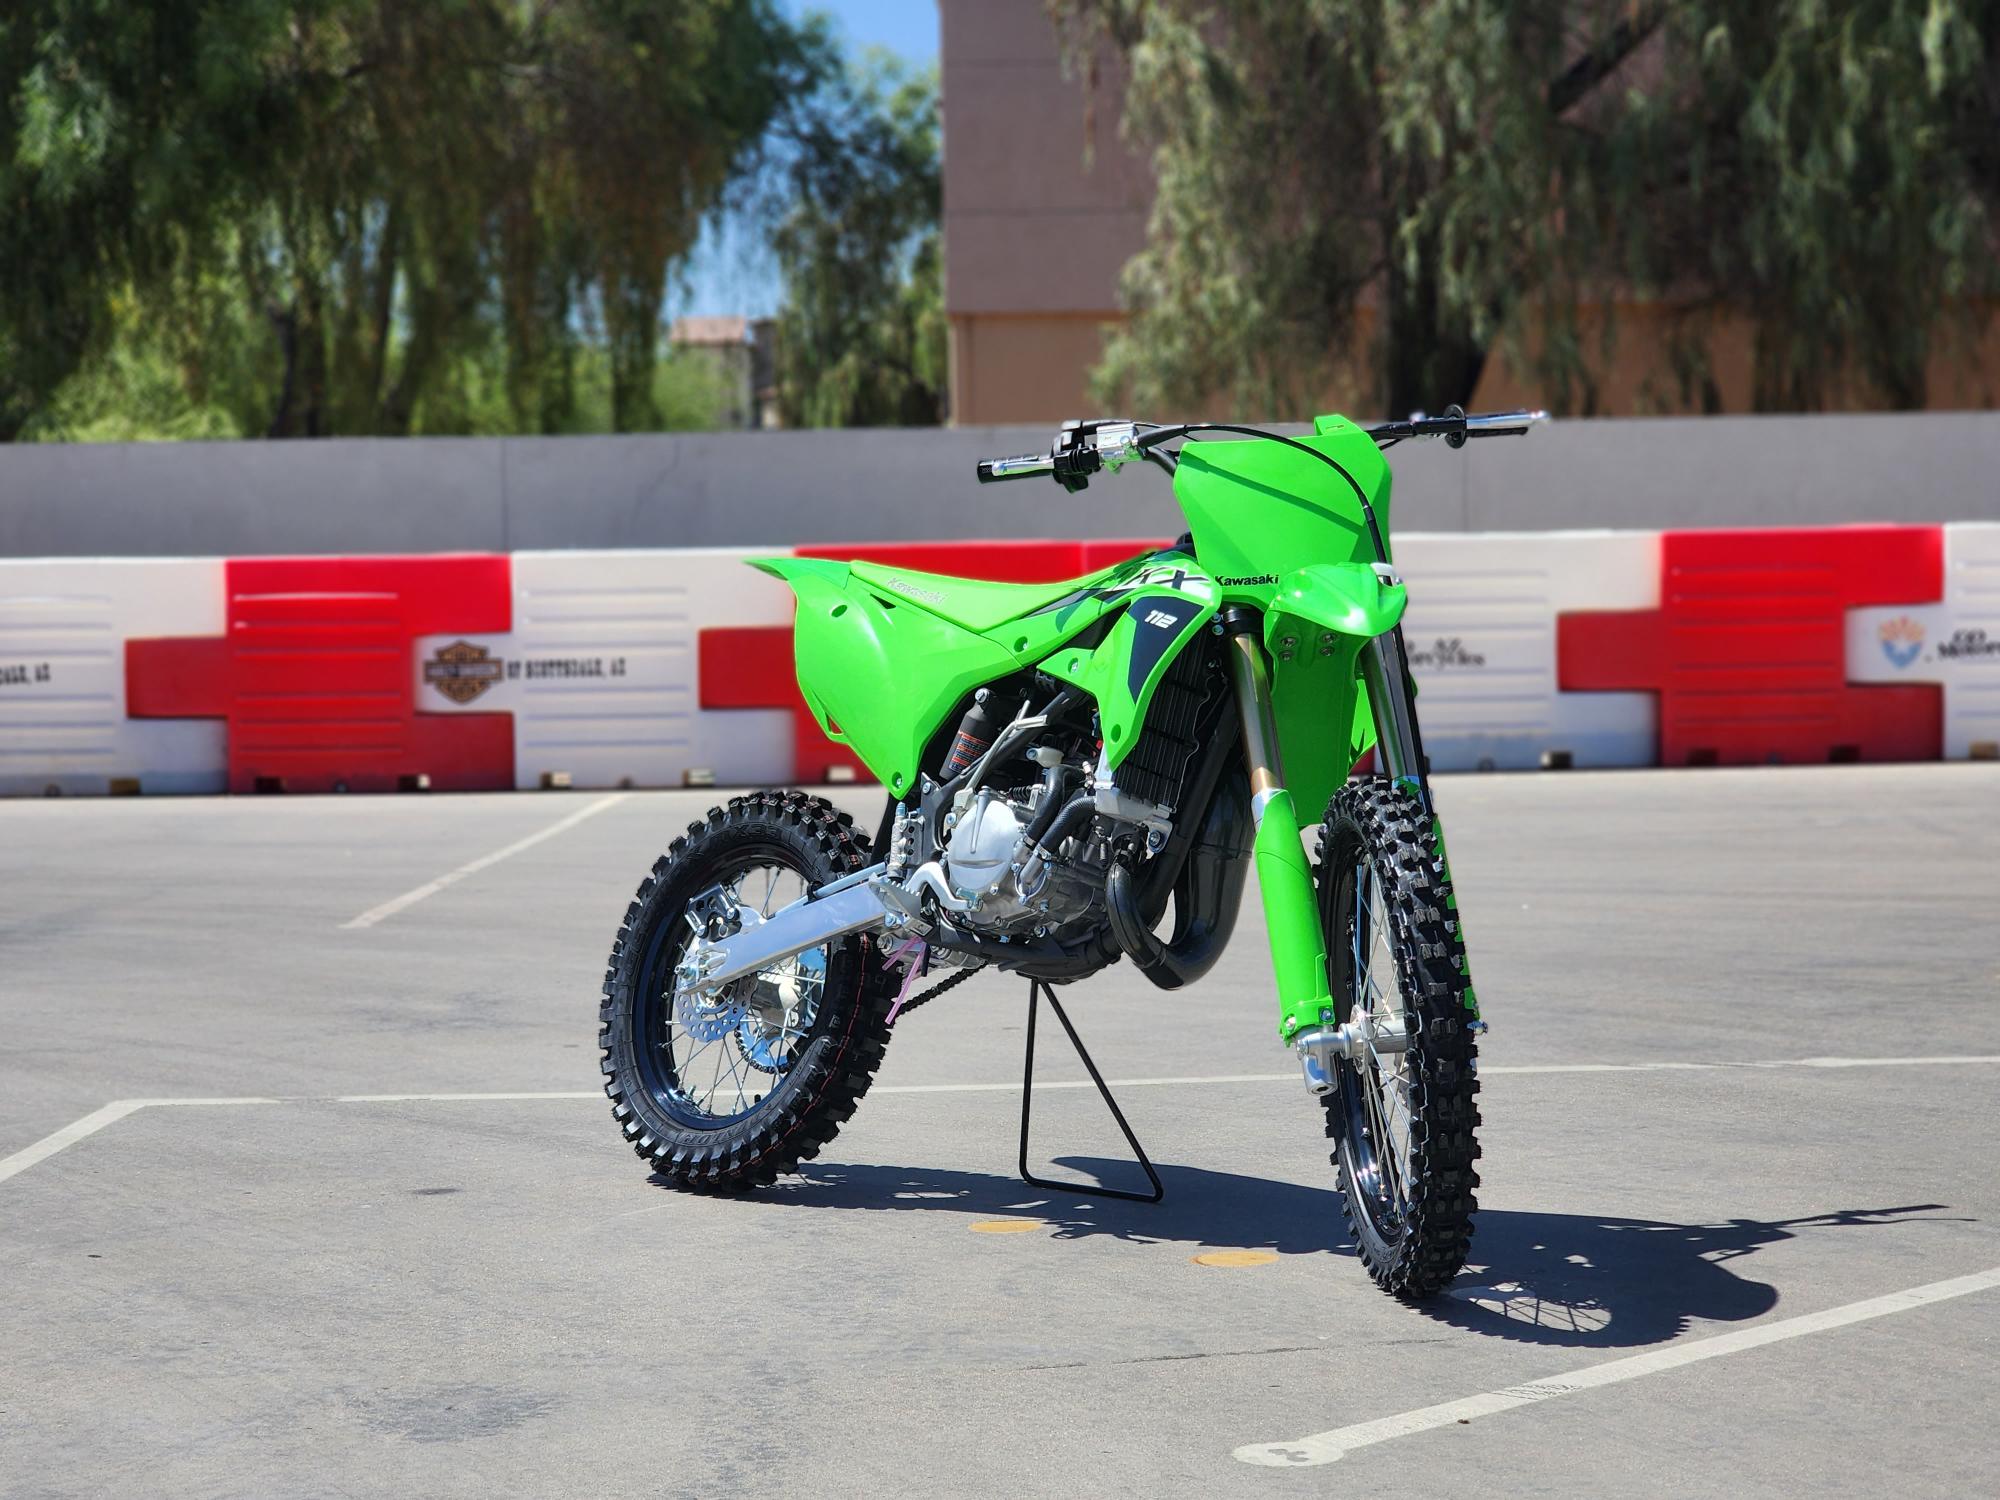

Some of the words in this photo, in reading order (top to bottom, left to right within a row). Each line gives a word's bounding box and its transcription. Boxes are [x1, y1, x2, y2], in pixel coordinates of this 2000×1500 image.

[887, 577, 950, 604] Kawasaki
[1214, 574, 1280, 588] Kawasaki
[1144, 609, 1178, 629] 112
